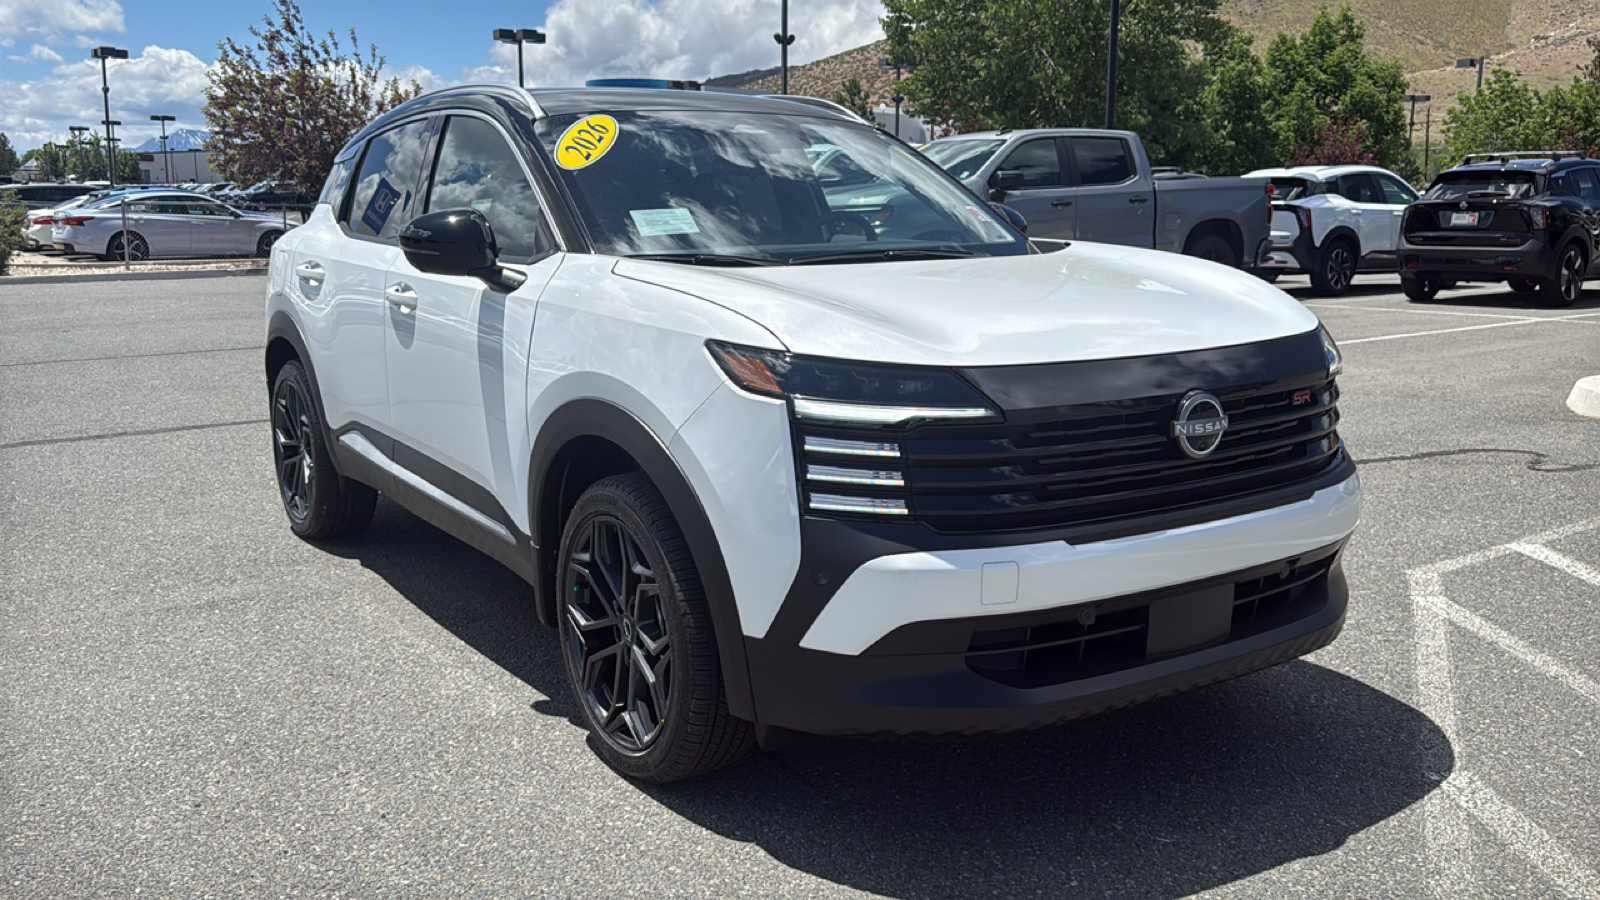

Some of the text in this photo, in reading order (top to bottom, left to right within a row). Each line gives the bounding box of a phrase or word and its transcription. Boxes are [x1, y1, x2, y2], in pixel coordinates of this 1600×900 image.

[565, 120, 609, 160] 2026
[1293, 389, 1311, 405] SR
[1177, 419, 1227, 435] NISSAN
